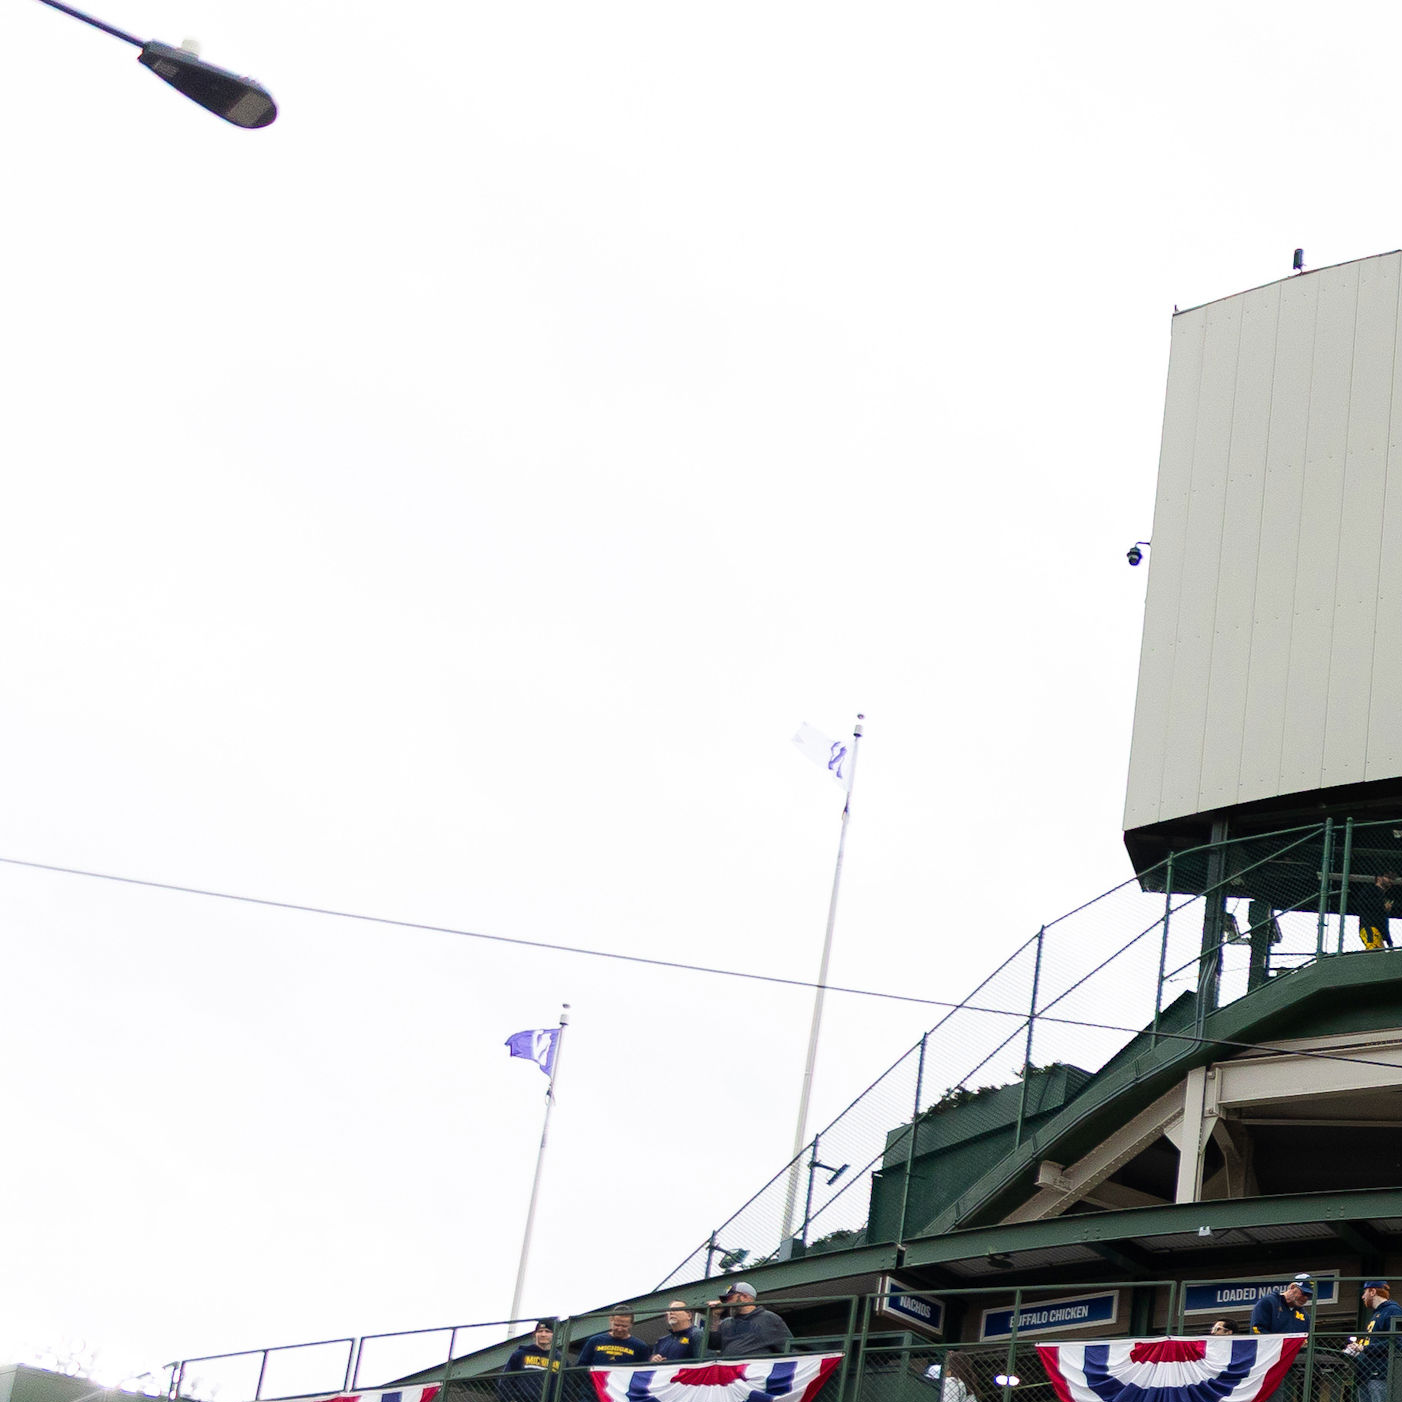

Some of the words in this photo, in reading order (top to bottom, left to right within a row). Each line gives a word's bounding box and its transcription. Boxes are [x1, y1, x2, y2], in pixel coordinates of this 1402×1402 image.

[1217, 1287, 1257, 1303] LOADED
[900, 1295, 931, 1319] NACHOS
[1049, 1305, 1089, 1323] CHICKEN
[596, 1344, 635, 1356] MICHIGAN
